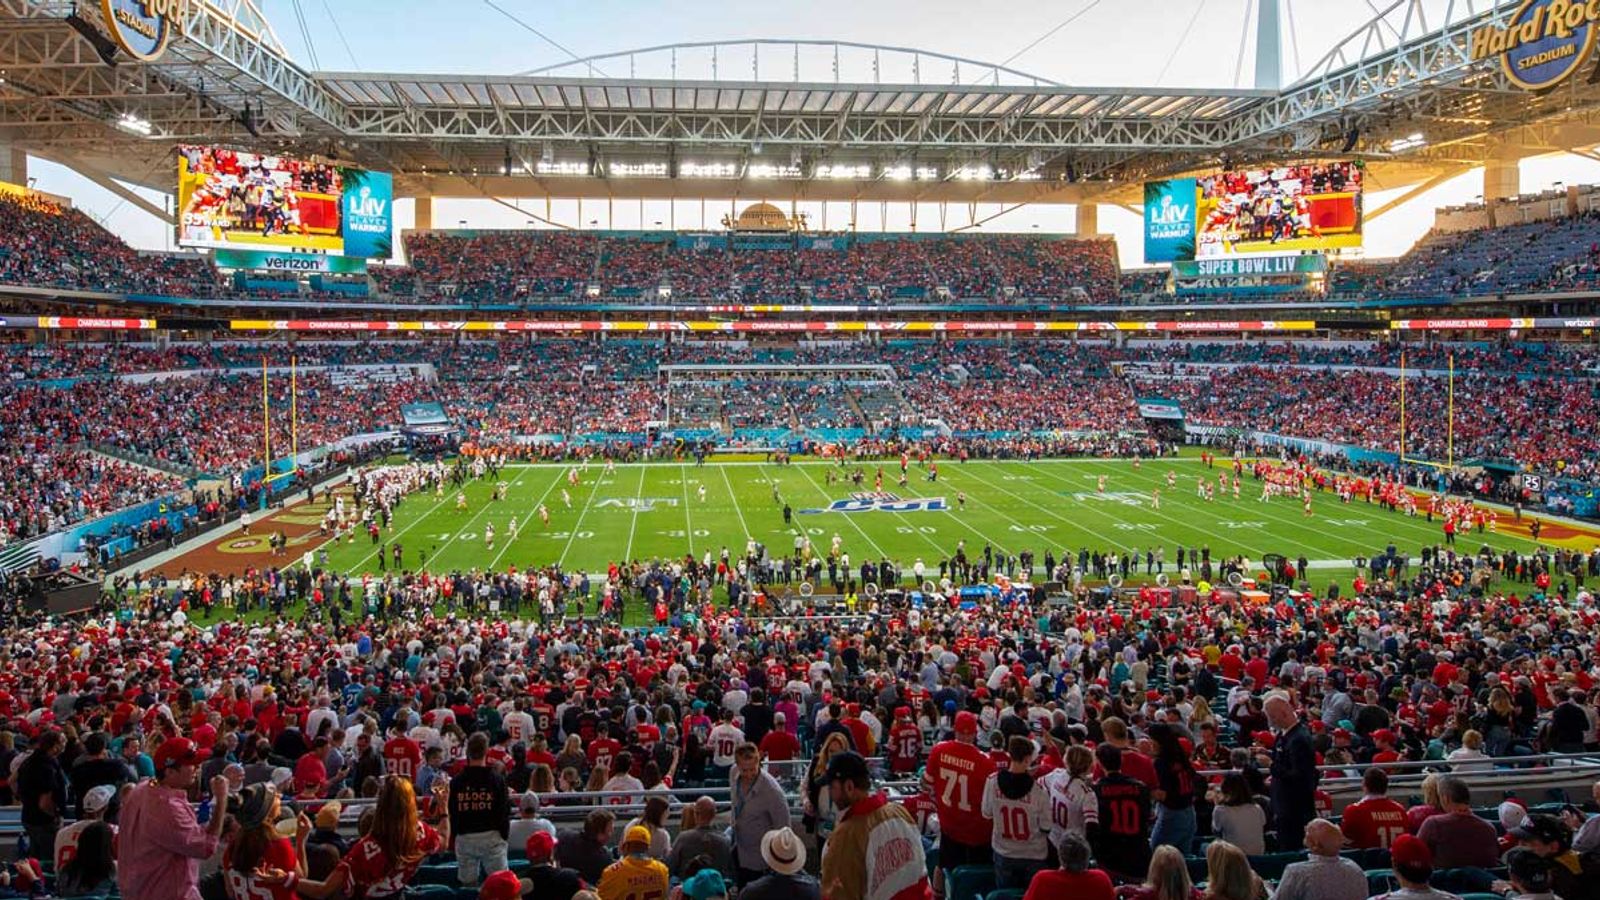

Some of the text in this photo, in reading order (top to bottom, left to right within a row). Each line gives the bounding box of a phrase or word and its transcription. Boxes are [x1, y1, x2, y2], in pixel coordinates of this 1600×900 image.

[1471, 6, 1546, 60] Hard
[1518, 43, 1575, 69] STADIUM
[265, 256, 319, 270] verizon
[1199, 257, 1296, 275] SUPER BOWL LIV
[1564, 318, 1595, 327] verizon
[1525, 476, 1539, 489] 25
[718, 739, 734, 756] 10
[939, 767, 972, 812] 71
[1000, 806, 1031, 841] 10
[1052, 796, 1069, 829] 10
[1110, 799, 1141, 834] 10
